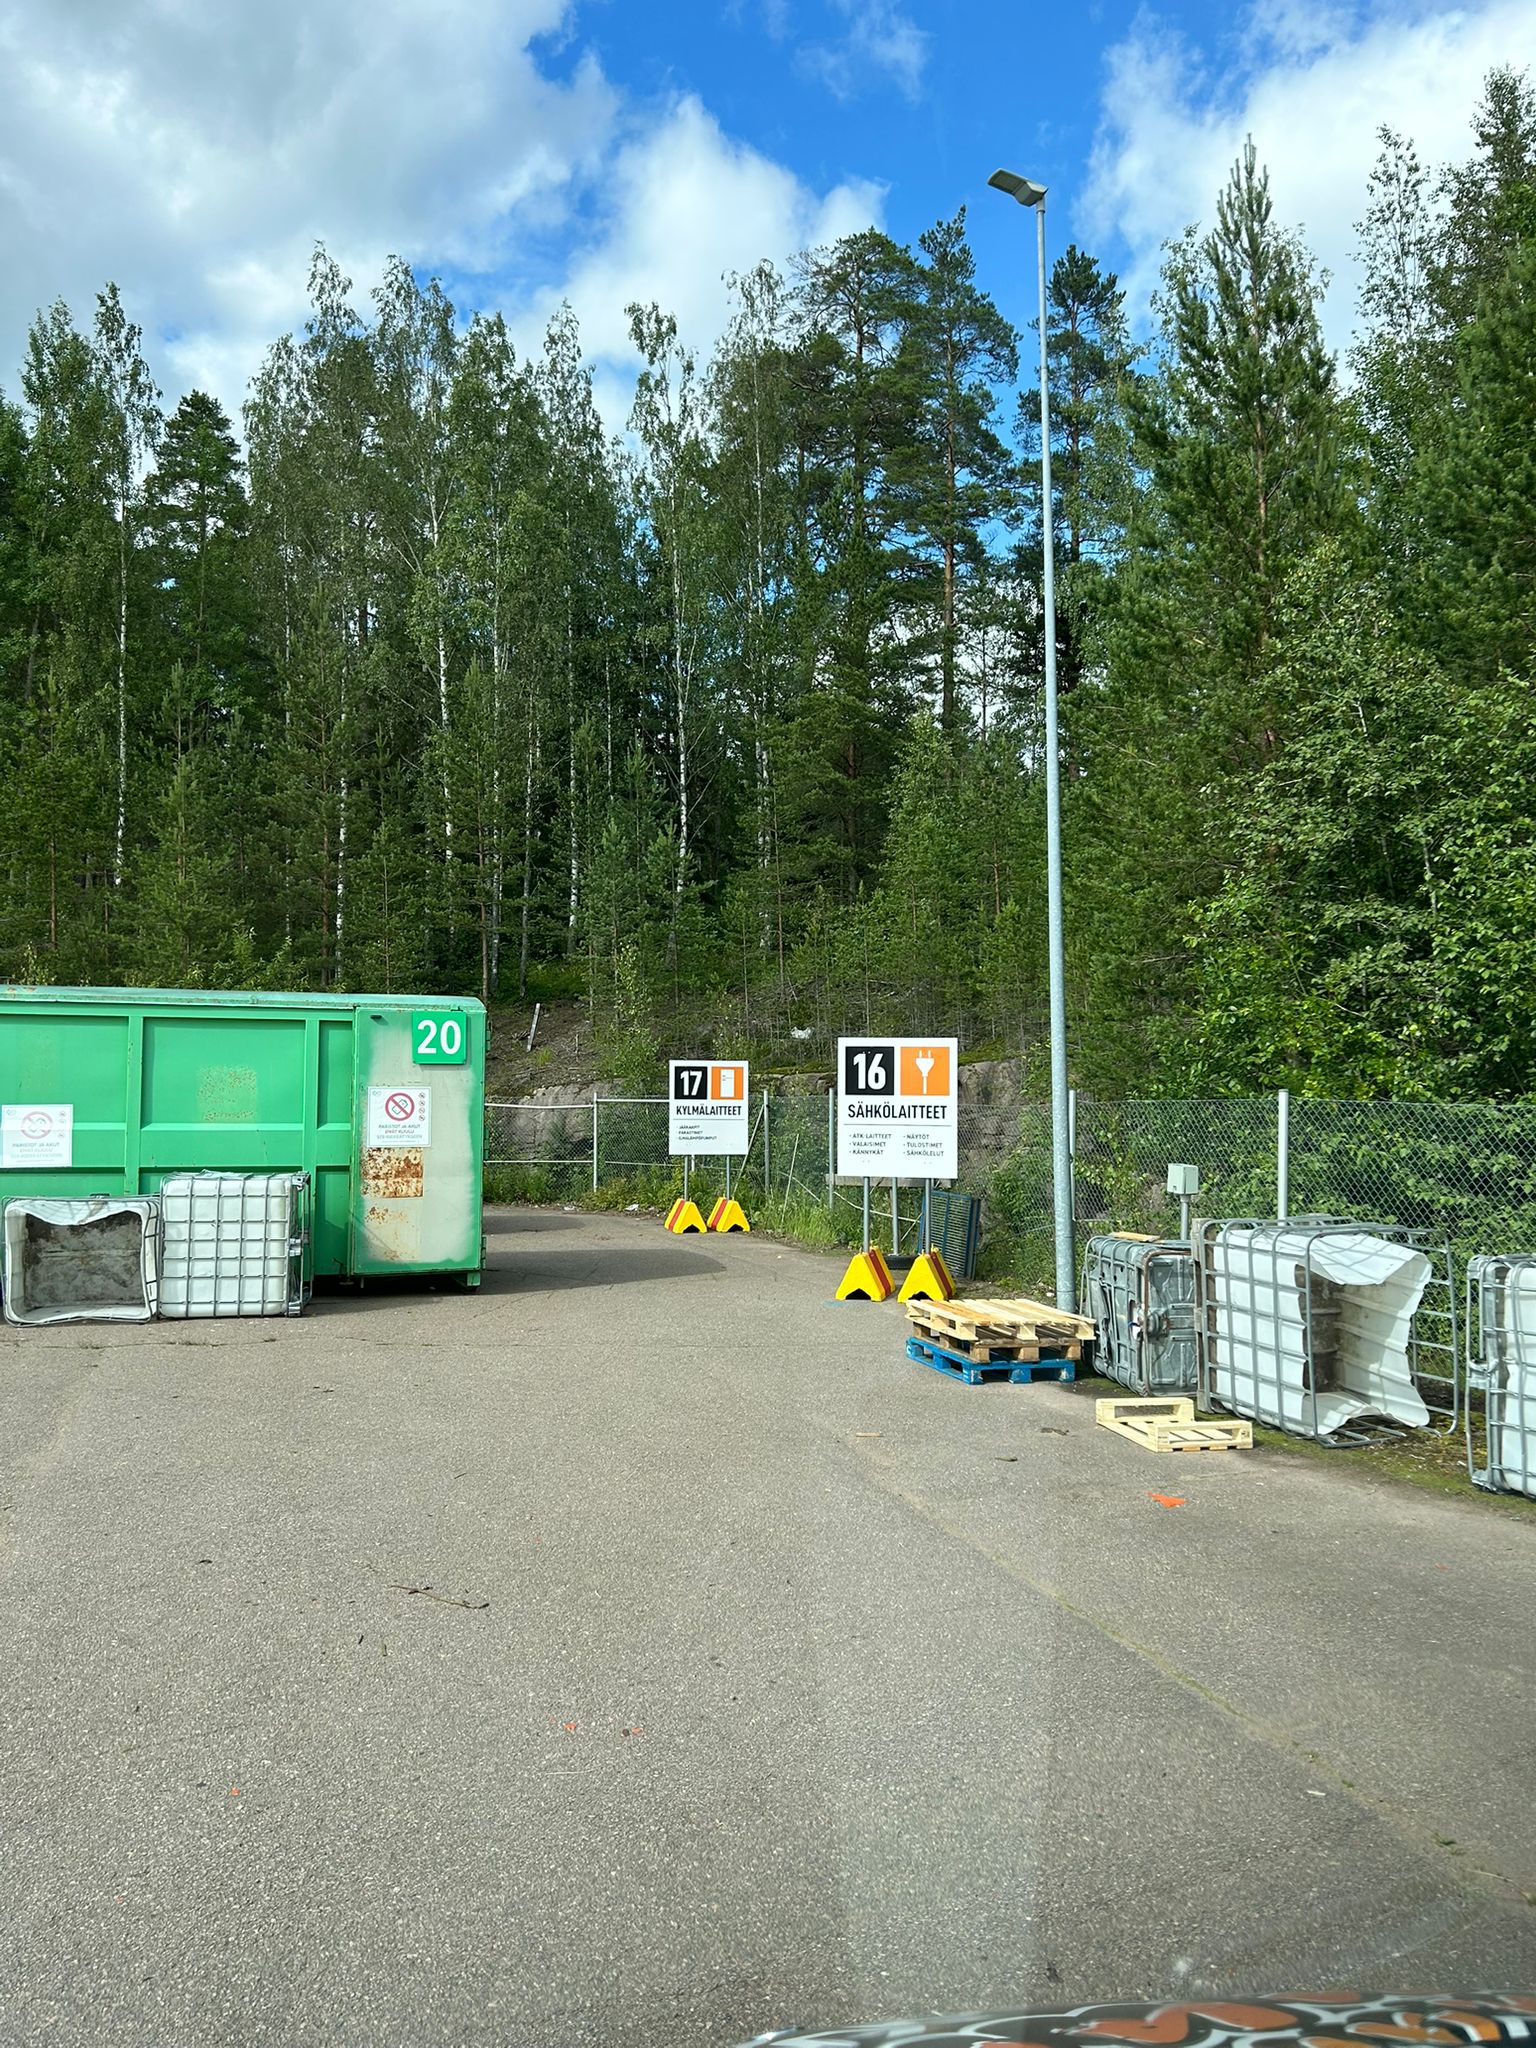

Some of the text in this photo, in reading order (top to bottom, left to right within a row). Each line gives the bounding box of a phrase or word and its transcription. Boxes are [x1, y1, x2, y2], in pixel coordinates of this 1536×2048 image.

[417, 1019, 461, 1055] 20
[680, 1070, 703, 1096] 17
[853, 1053, 886, 1090] 16
[676, 1103, 742, 1116] KYLMÄLAITTEET
[848, 1101, 947, 1119] SÄHKÖLAITTEET
